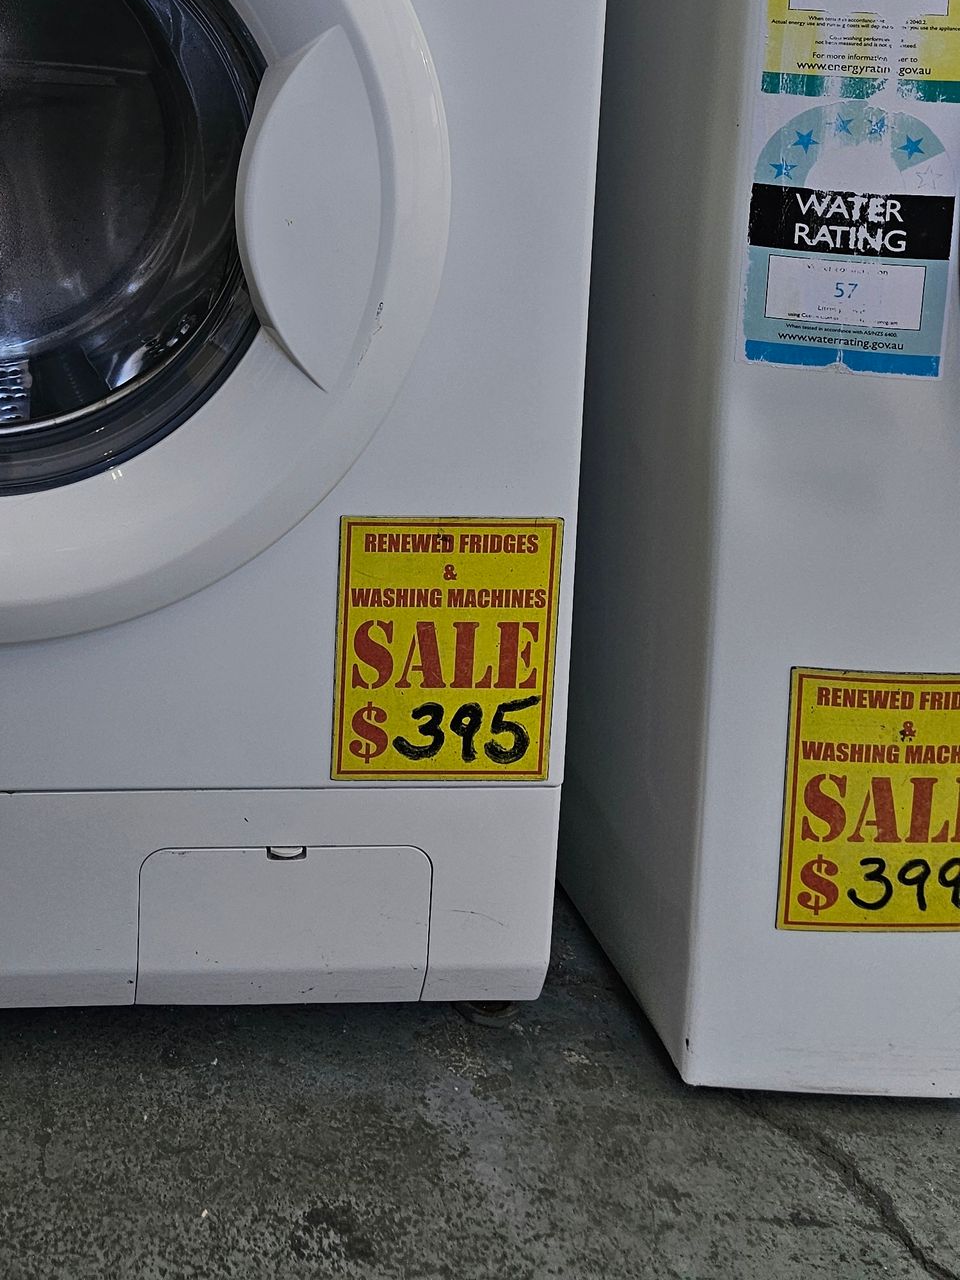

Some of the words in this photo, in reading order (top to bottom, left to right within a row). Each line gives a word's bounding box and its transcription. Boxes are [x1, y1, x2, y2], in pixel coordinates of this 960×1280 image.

[796, 193, 903, 222] WATER
[794, 223, 906, 252] RATING
[834, 283, 858, 298] 57
[365, 534, 454, 552] RENEWED
[459, 534, 538, 553] FRIDGES
[444, 564, 457, 580] &
[352, 588, 442, 607] WASHING
[447, 589, 546, 608] MACHINES
[352, 620, 539, 689] SALE
[817, 687, 914, 709] RENEWED
[802, 740, 899, 763] WASHING
